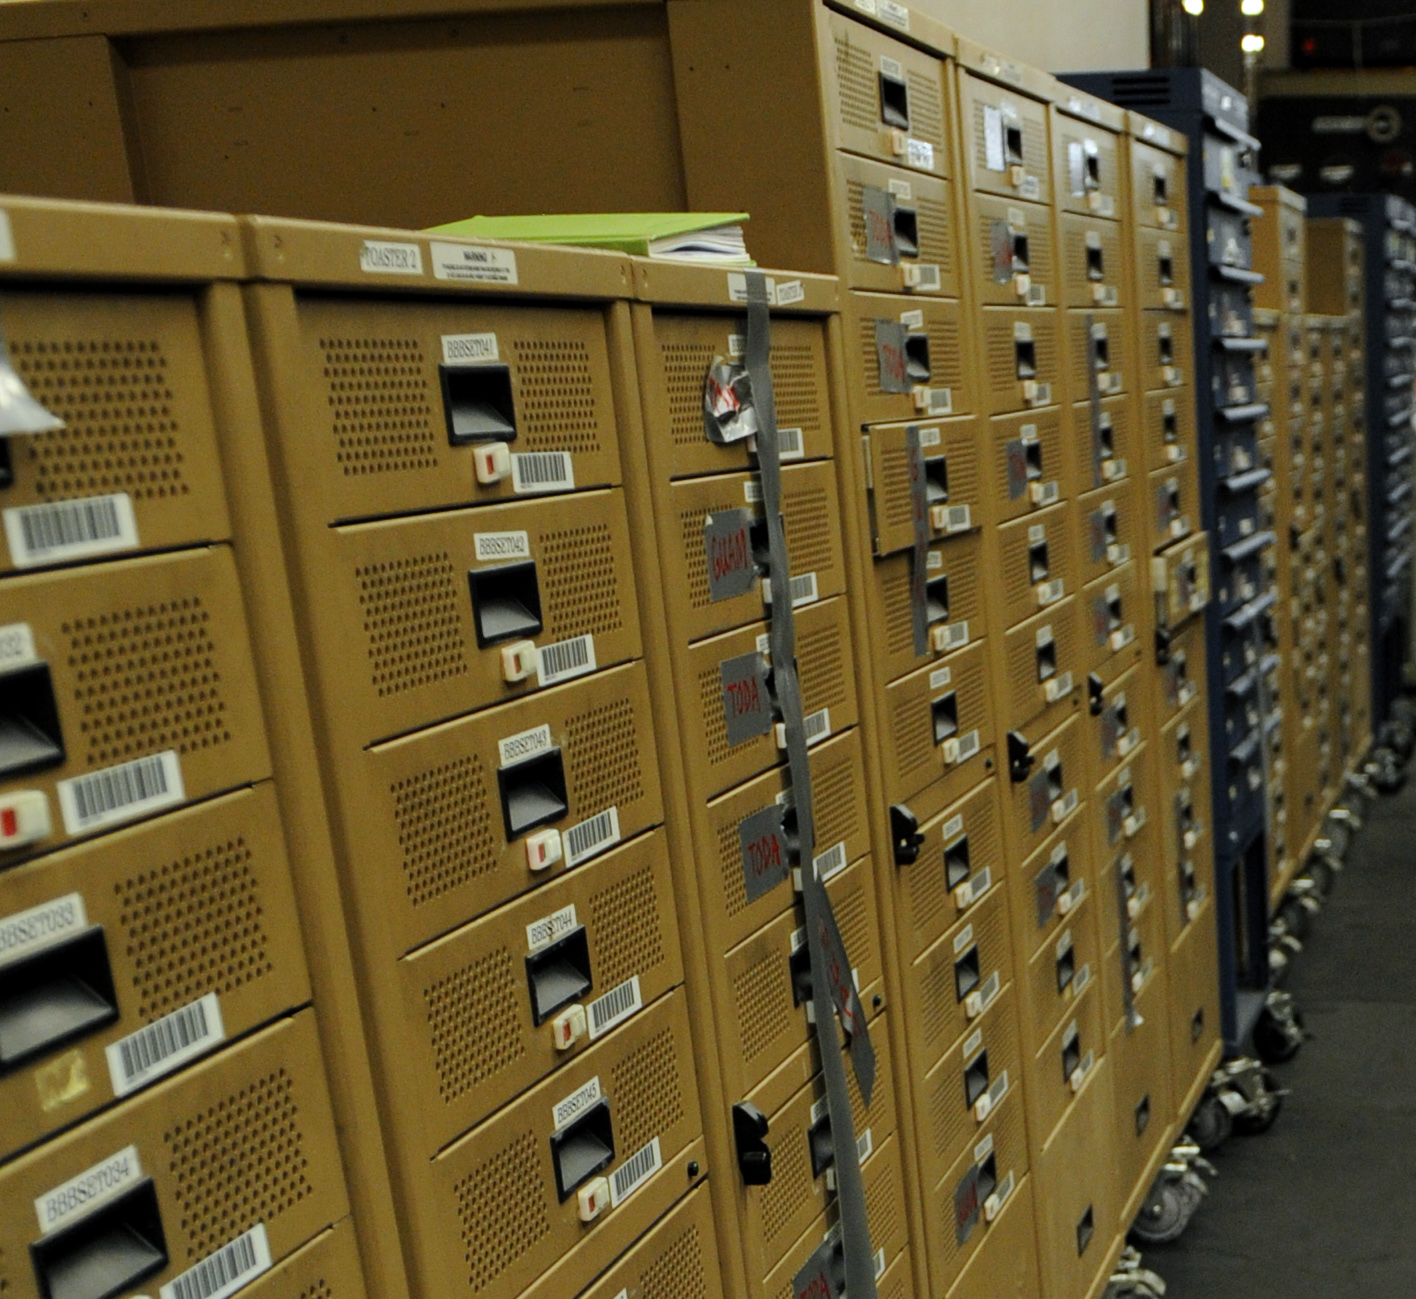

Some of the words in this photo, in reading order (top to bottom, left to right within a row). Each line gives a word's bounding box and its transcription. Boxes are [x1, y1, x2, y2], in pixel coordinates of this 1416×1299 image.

[364, 247, 407, 268] TOASTER
[409, 251, 417, 269] 2
[446, 338, 493, 358] BBBSET041
[479, 535, 525, 556] BBBSET042
[503, 730, 548, 760] BBBSET043
[531, 913, 573, 944] BBBSET044
[557, 1083, 597, 1124] BBBSET045
[46, 1156, 130, 1222] BBBSET034
